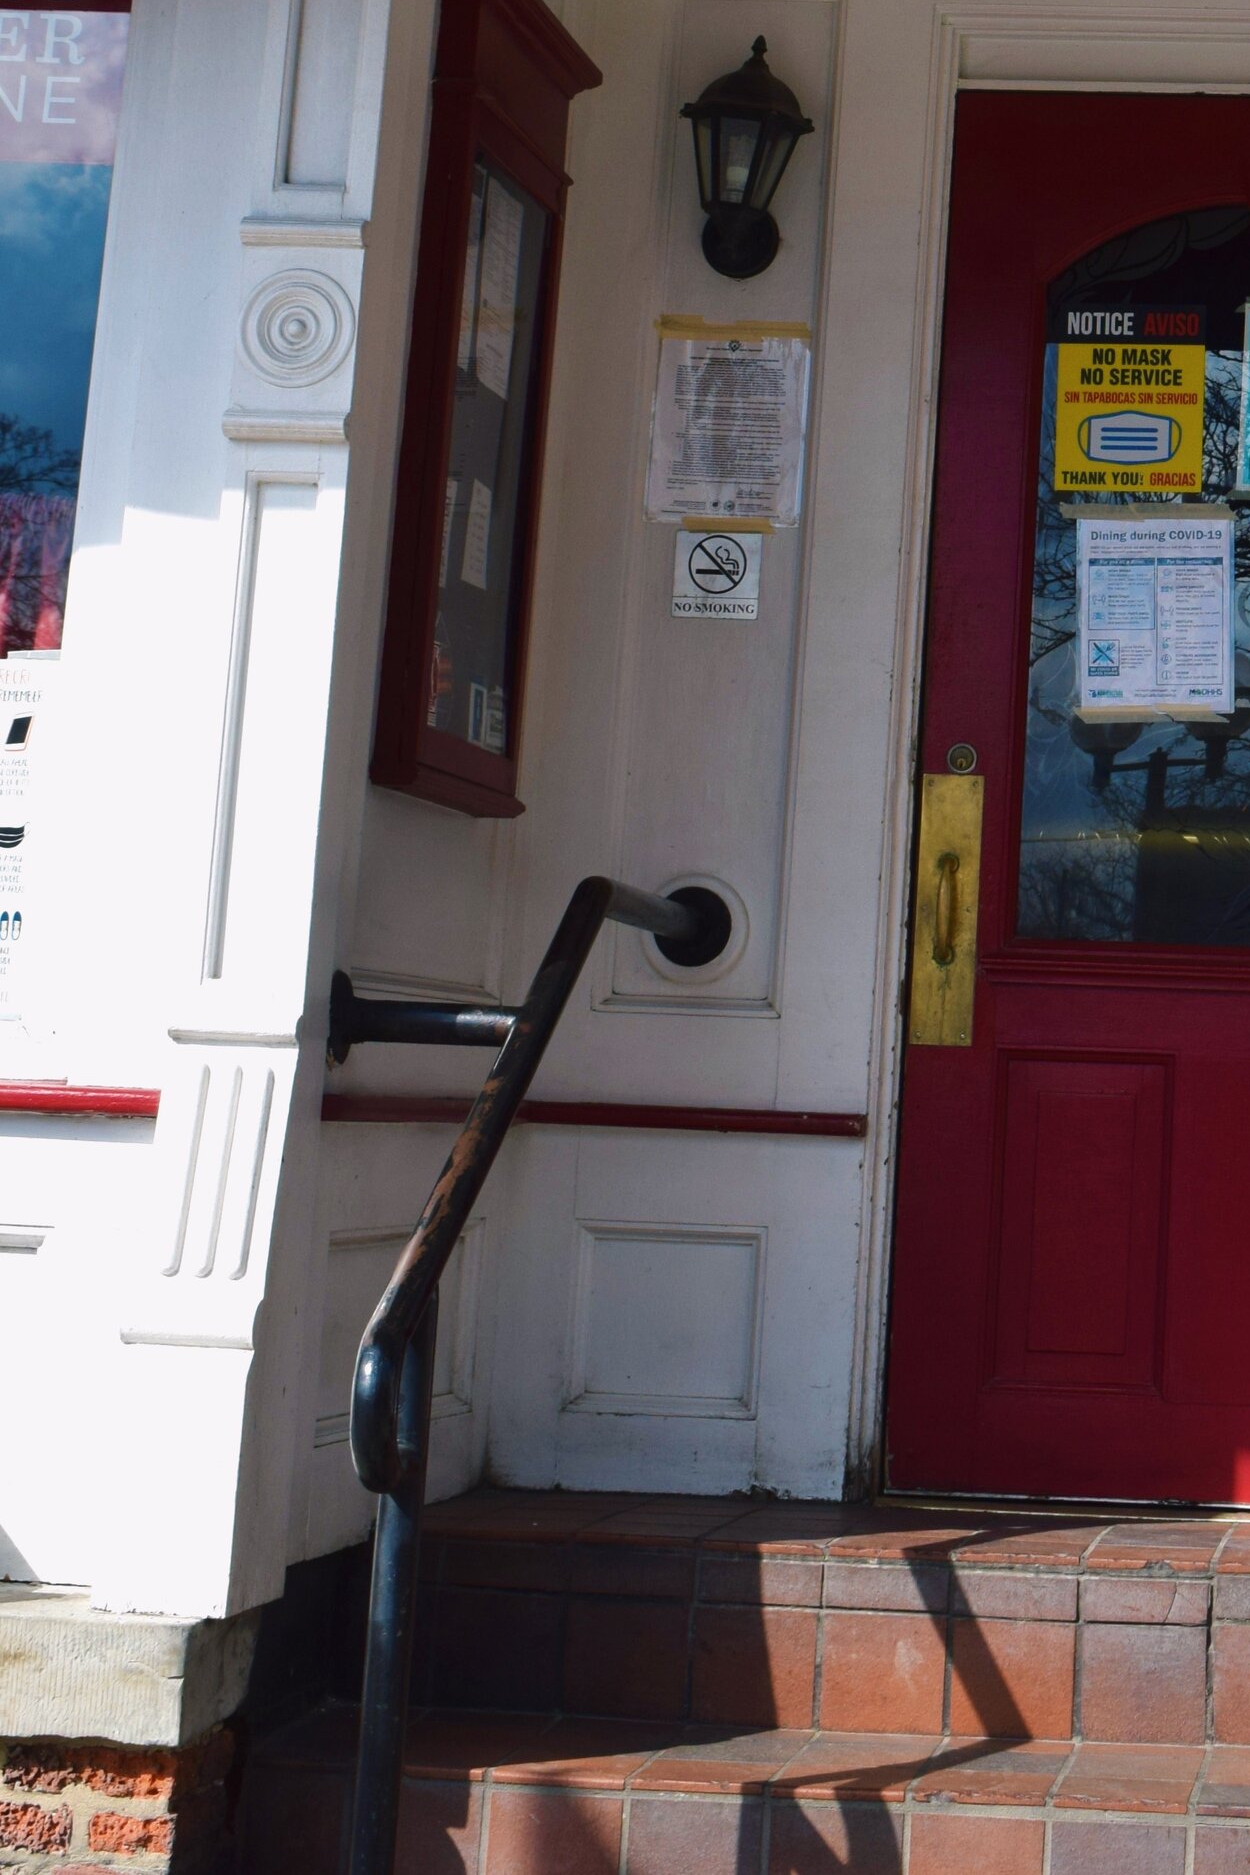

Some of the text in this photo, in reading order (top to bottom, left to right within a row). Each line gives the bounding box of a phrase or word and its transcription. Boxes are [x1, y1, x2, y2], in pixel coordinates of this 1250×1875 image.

[1067, 312, 1200, 337] NOTICE AVISO
[1092, 348, 1172, 366] NO MASK
[1080, 368, 1183, 386] NO SERVICE
[1064, 391, 1198, 405] SIN TAPABOCAS SIN SERVICIO
[1062, 471, 1196, 487] THANK YOU! GRACIAS
[1091, 530, 1223, 542] Dining during COVID-19
[673, 603, 755, 614] NO SMOKING
